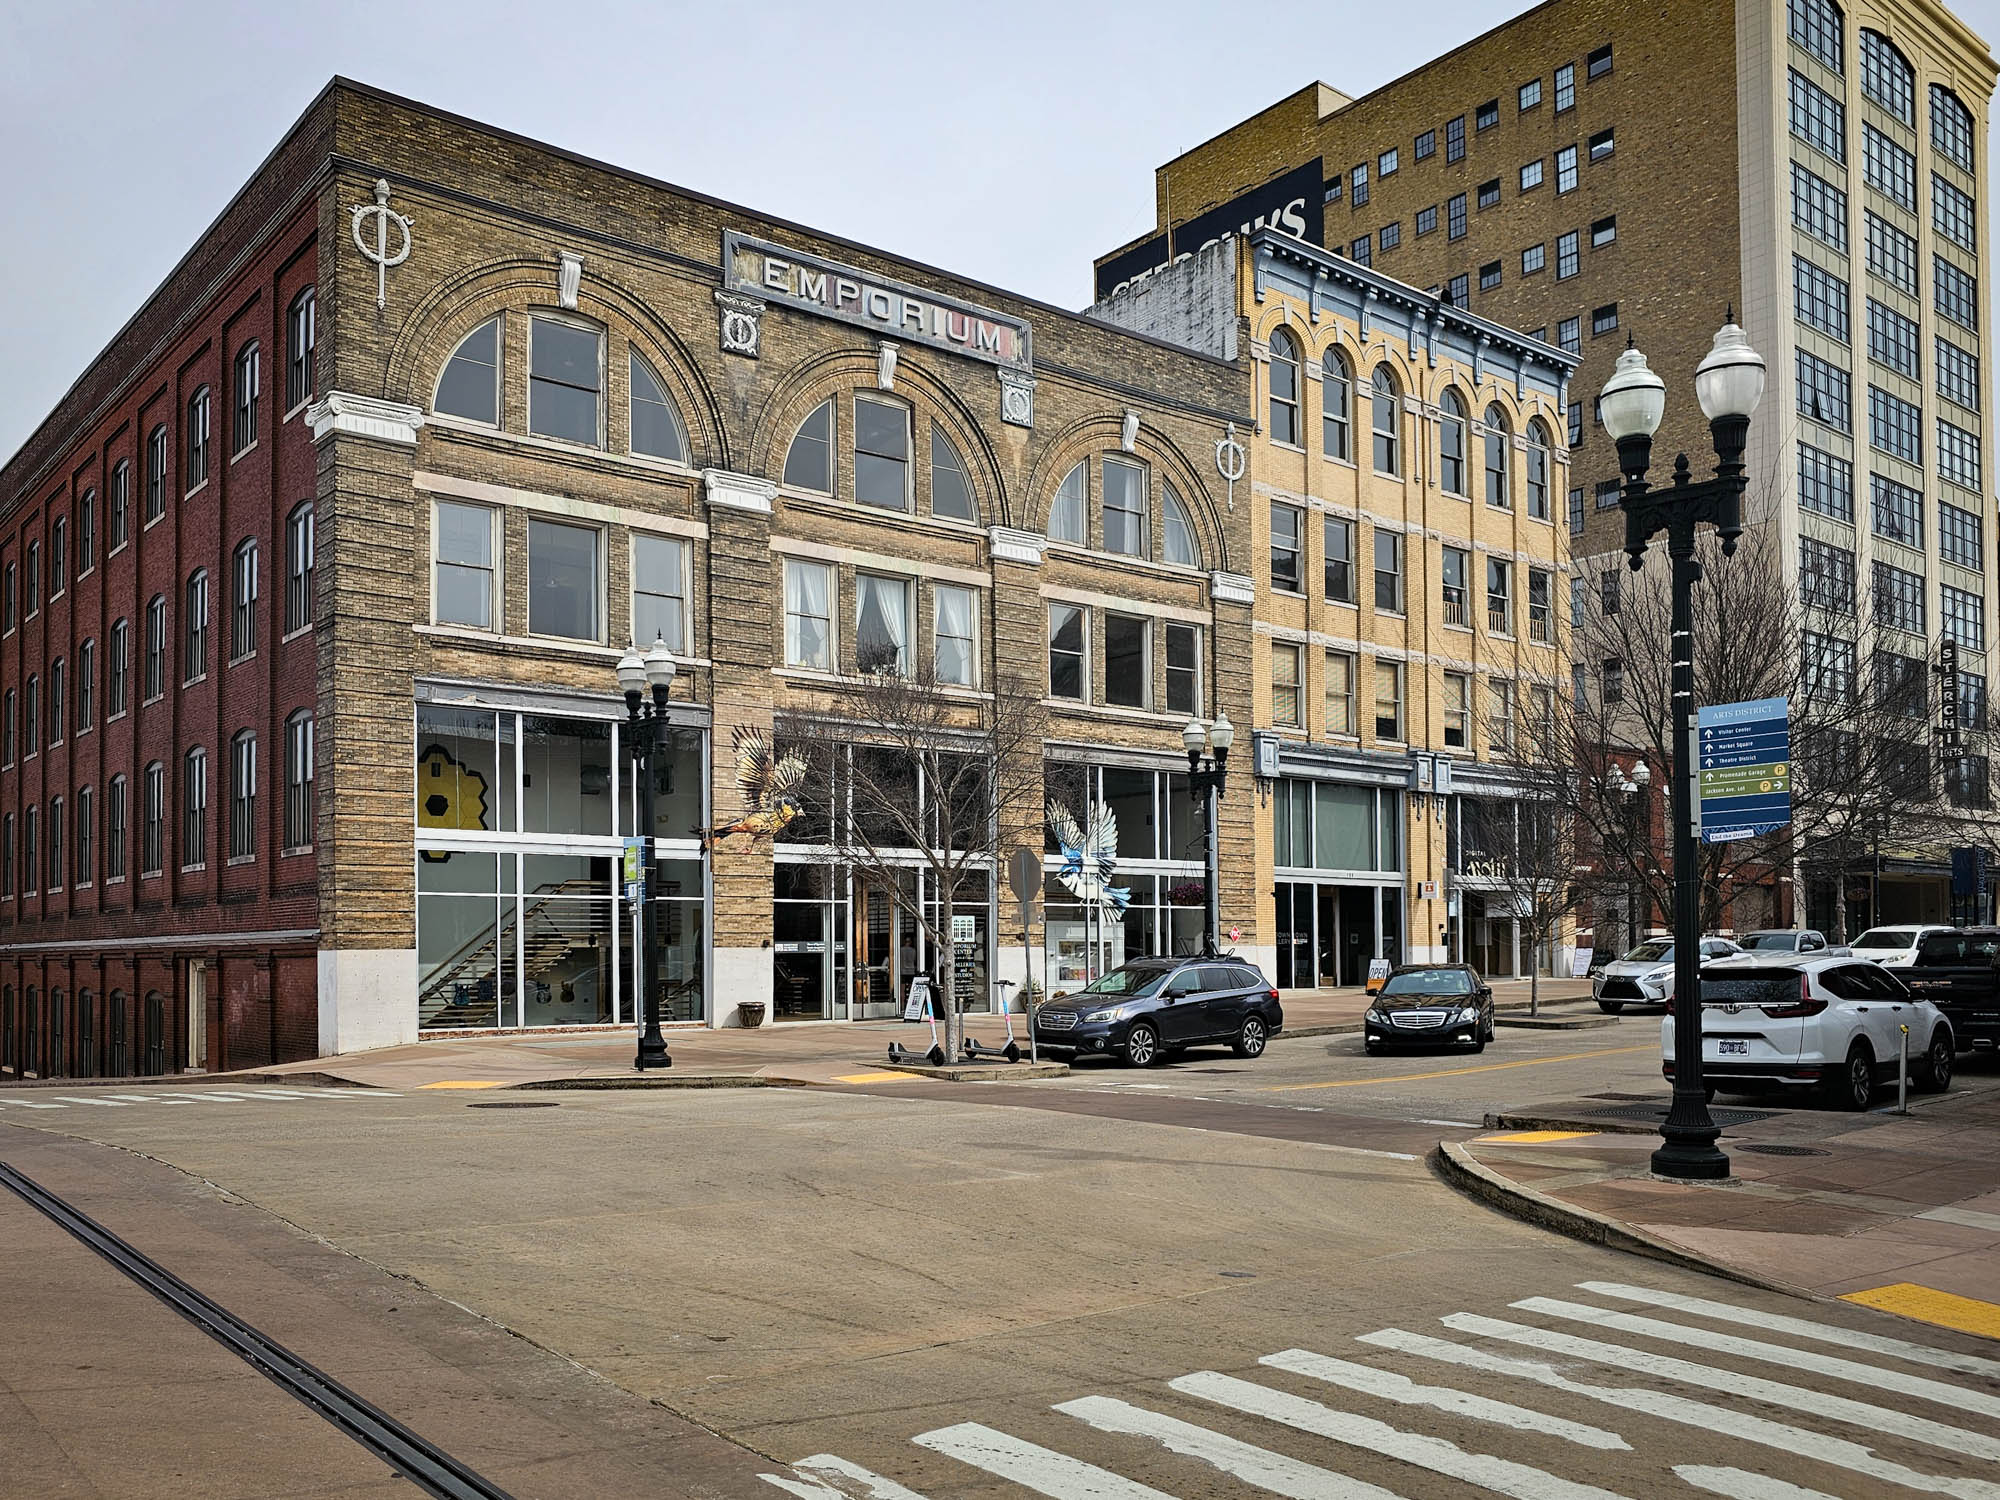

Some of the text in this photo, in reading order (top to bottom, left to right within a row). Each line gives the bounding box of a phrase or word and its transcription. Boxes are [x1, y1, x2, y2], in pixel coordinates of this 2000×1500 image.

[764, 257, 1001, 352] EMPORIUM
[1942, 649, 1954, 743] STERCHI
[1713, 706, 1772, 719] ARTS DISTRICT
[1736, 741, 1753, 749] Square
[1369, 967, 1388, 979] OPEN
